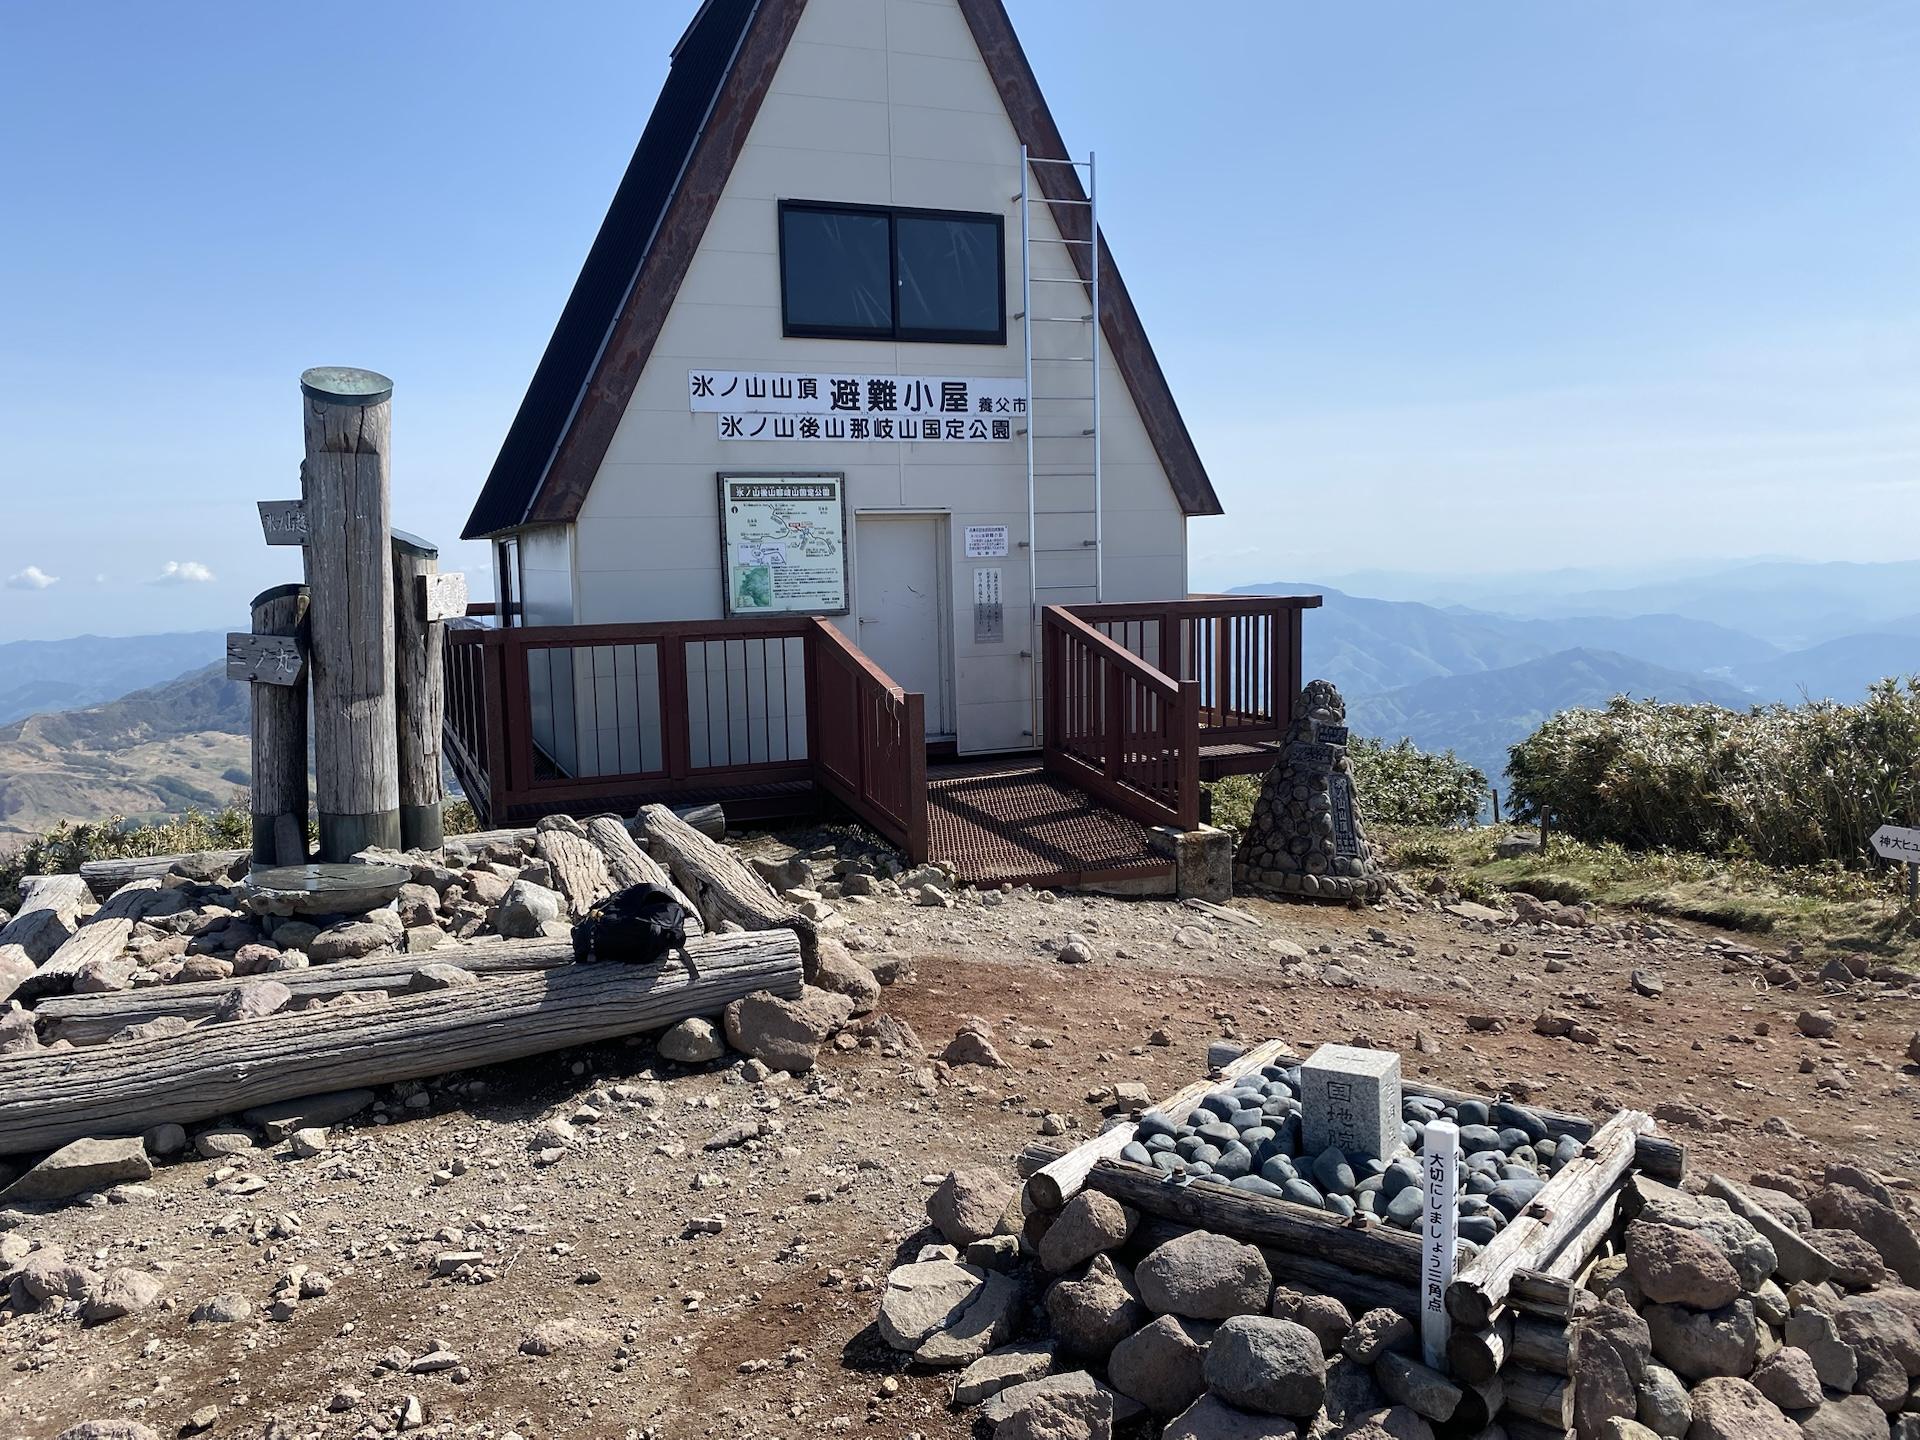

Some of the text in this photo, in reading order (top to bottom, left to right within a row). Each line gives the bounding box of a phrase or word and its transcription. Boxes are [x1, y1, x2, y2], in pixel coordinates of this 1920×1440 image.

[691, 375, 1027, 413] 氷ノ山山頂 避難小屋 養父市
[721, 415, 1011, 440] 氷ノ山後山那岐山国定公園
[229, 648, 294, 673] 二ノ丸
[1326, 1081, 1354, 1152] 国地院
[1428, 1152, 1444, 1313] 大切にしましょう三角点
